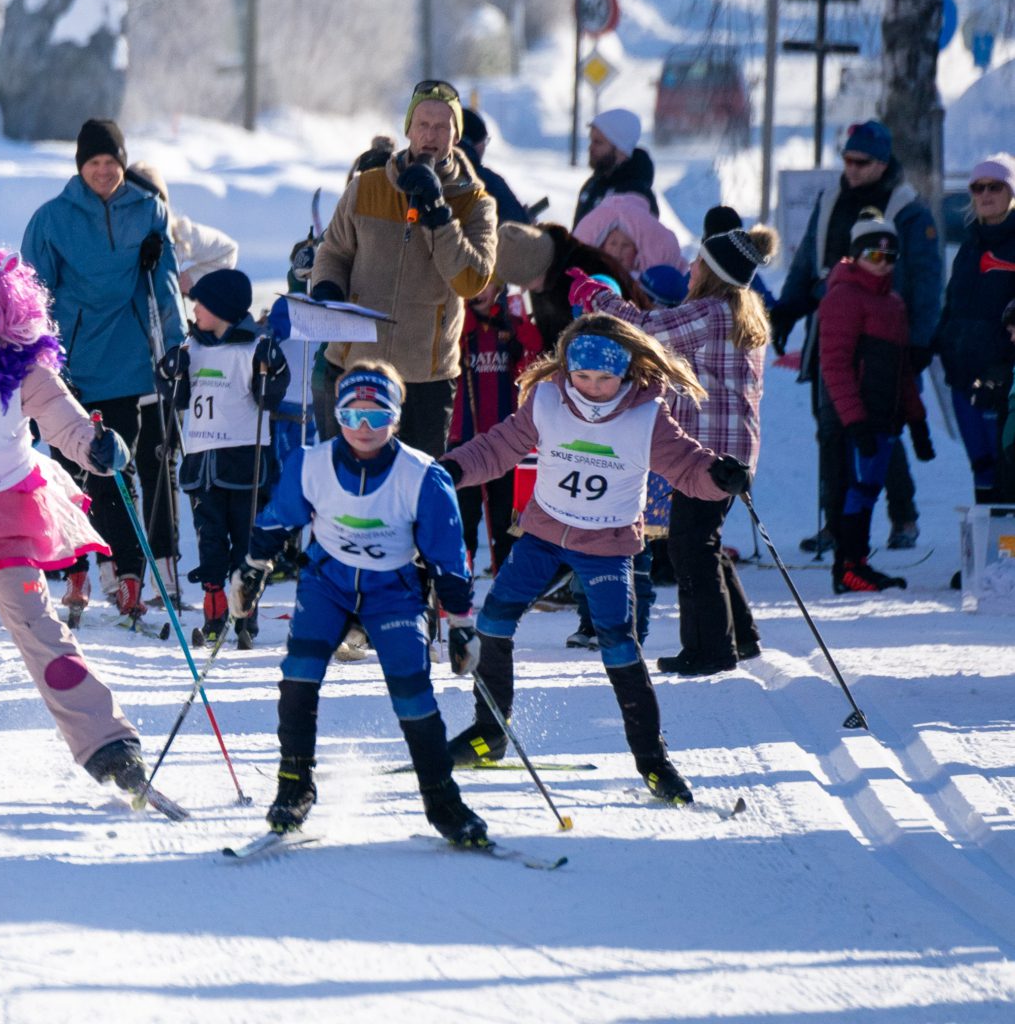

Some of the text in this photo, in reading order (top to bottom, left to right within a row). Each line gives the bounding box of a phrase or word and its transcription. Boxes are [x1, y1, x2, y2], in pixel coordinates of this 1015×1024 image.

[193, 394, 214, 420] 61
[550, 450, 626, 471] SKUE SPAREBANK
[557, 470, 608, 502] 49
